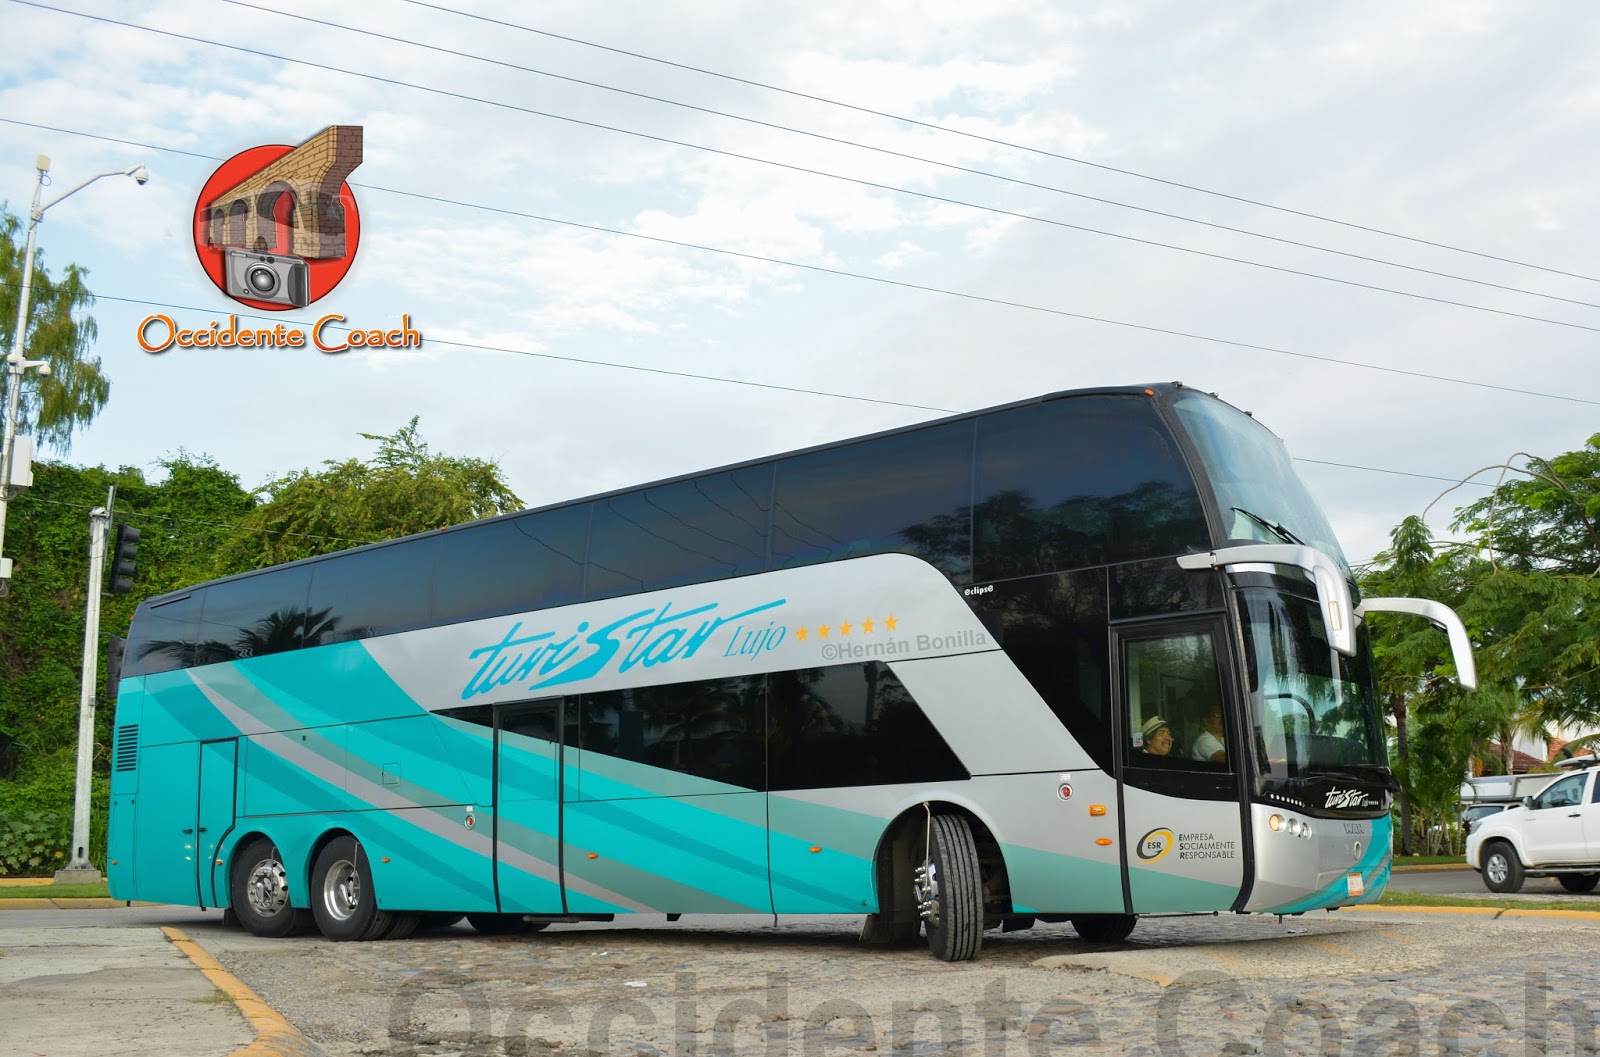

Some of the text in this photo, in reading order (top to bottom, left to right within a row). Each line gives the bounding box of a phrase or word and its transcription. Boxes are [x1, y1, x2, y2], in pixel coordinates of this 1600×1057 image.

[724, 620, 787, 661] Lujo
[1178, 832, 1214, 842] EMPRESA
[1147, 841, 1162, 850] ESR
[1179, 841, 1235, 851] SOCIALMENTE
[1180, 850, 1235, 860] RESPONSABLE
